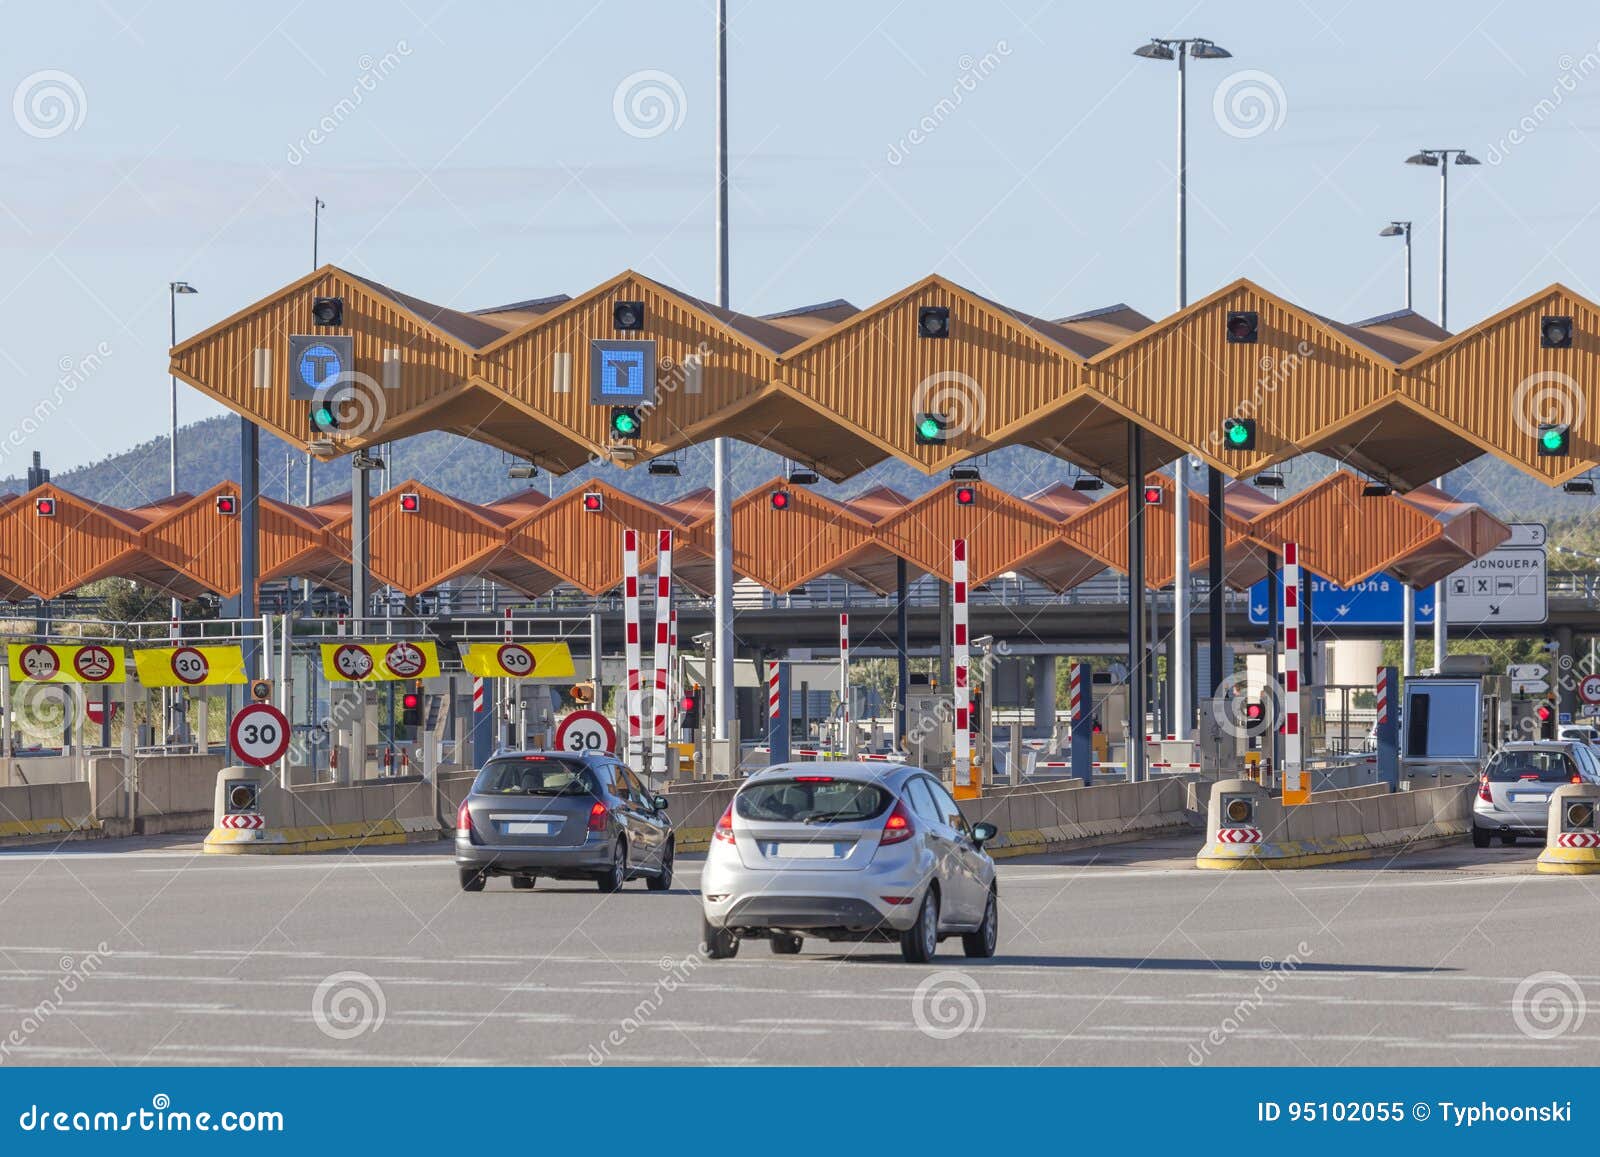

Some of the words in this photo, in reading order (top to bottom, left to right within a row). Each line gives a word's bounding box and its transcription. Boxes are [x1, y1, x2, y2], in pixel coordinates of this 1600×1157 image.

[1472, 559, 1540, 569] JONQUERA
[1298, 578, 1390, 592] Barclona
[179, 659, 201, 672] 30
[505, 654, 528, 666] 30
[244, 724, 276, 745] 30
[570, 731, 601, 751] 30
